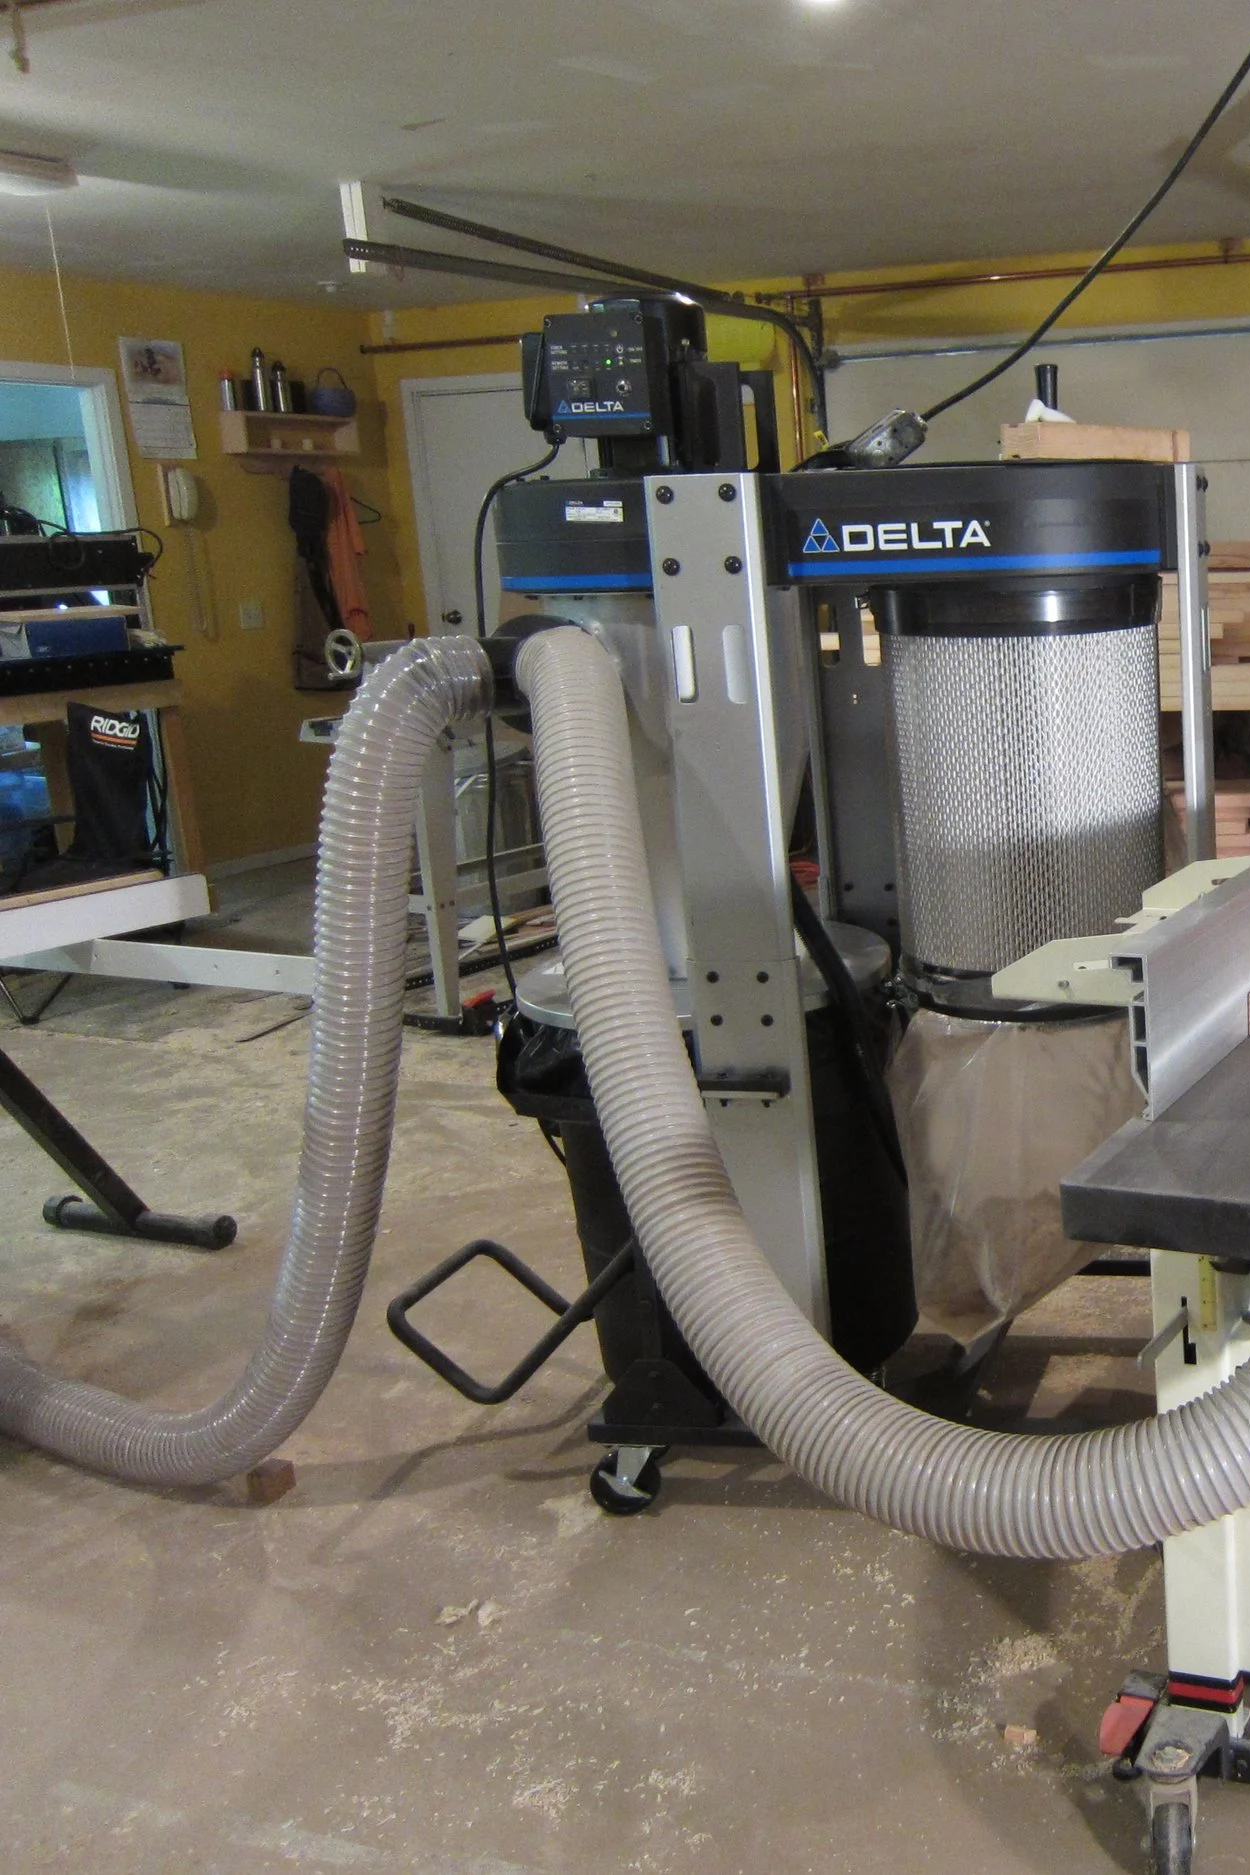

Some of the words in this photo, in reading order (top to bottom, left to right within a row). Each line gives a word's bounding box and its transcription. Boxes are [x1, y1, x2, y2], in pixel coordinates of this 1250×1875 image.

[571, 401, 624, 413] DELTA
[841, 519, 991, 551] DELTA
[91, 715, 140, 739] RIDGID
